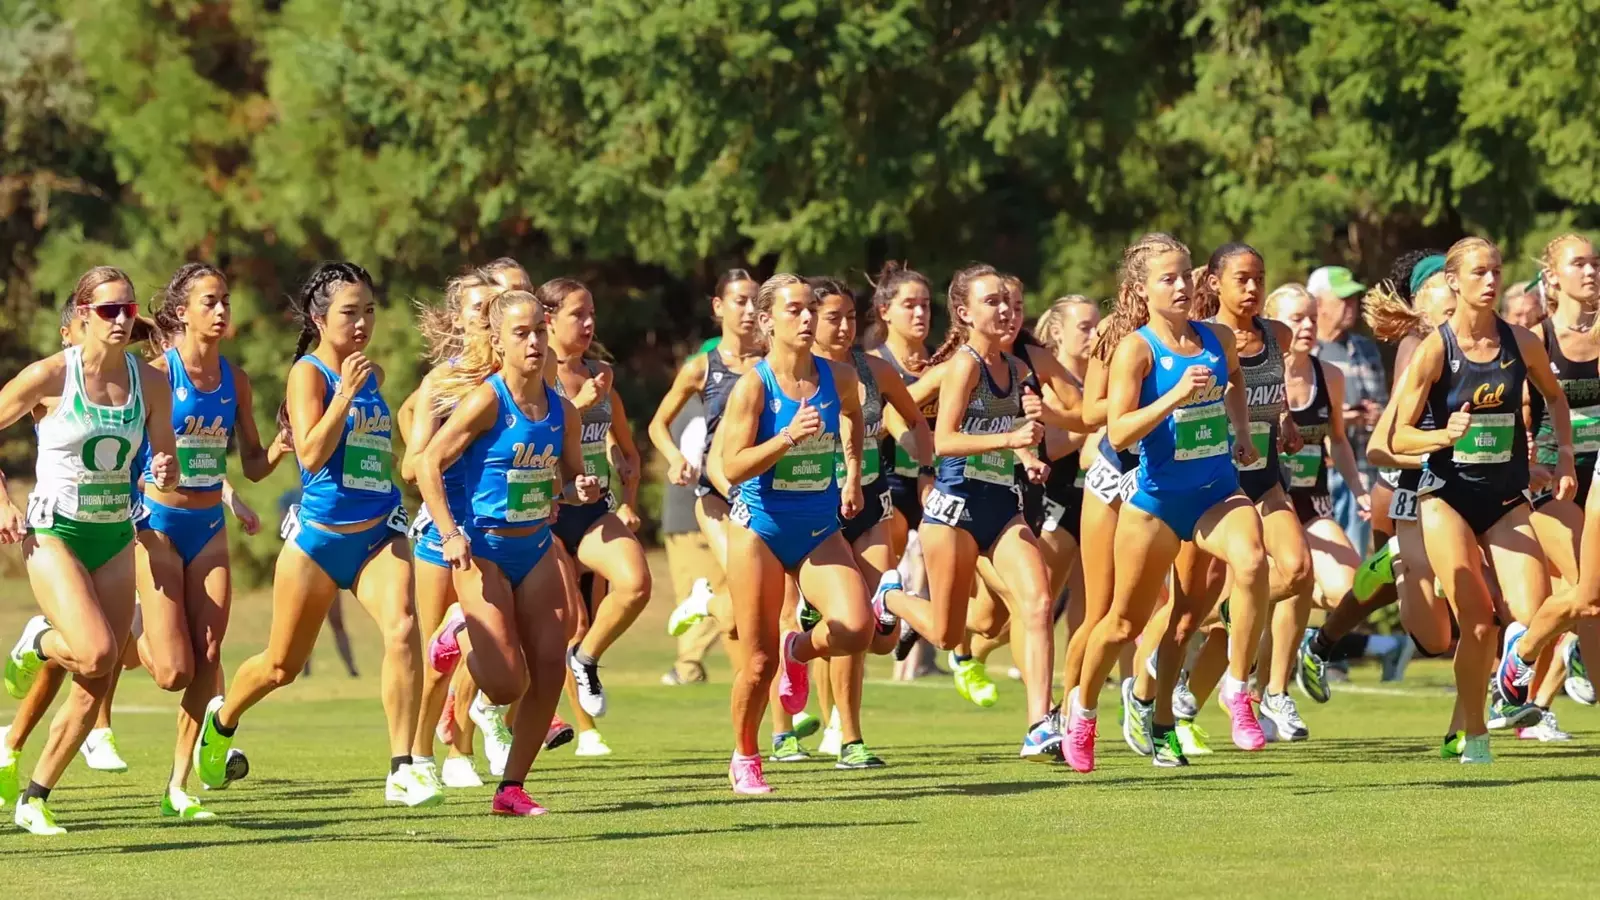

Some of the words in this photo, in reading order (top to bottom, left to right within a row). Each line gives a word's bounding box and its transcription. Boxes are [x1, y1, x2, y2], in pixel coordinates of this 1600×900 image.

[1473, 383, 1505, 410] Cal
[922, 403, 940, 418] al
[1195, 428, 1212, 441] KANE
[1474, 436, 1497, 447] YERBY
[512, 443, 558, 468] Ucla
[360, 459, 382, 473] CICHON
[792, 463, 822, 476] BROWNE
[79, 493, 131, 506] THORNTON-BOTT
